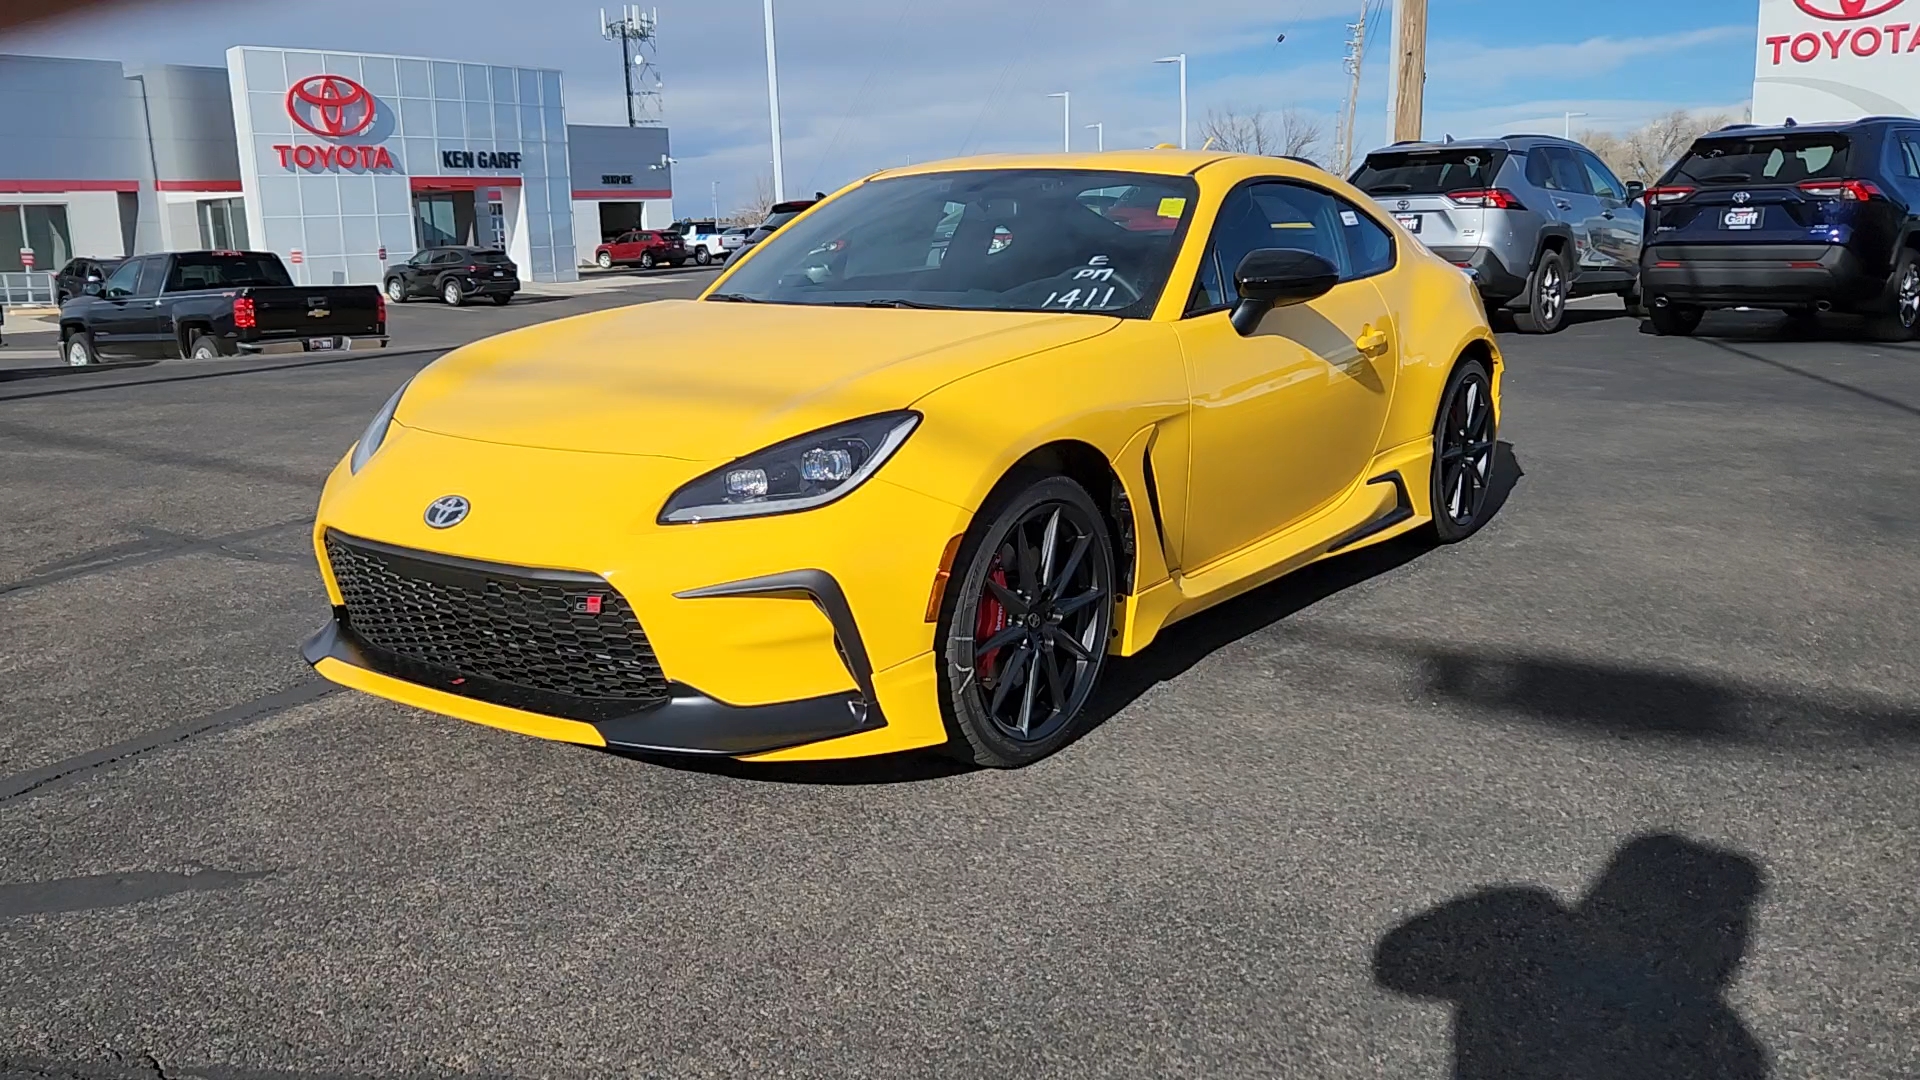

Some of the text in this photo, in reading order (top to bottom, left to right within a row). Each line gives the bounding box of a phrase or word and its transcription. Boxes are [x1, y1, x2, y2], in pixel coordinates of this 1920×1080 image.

[272, 145, 394, 169] TOYOTA
[442, 150, 522, 169] KEN GARFF
[1724, 212, 1758, 226] Garff
[1088, 255, 1109, 266] E
[1041, 286, 1115, 308] 1411
